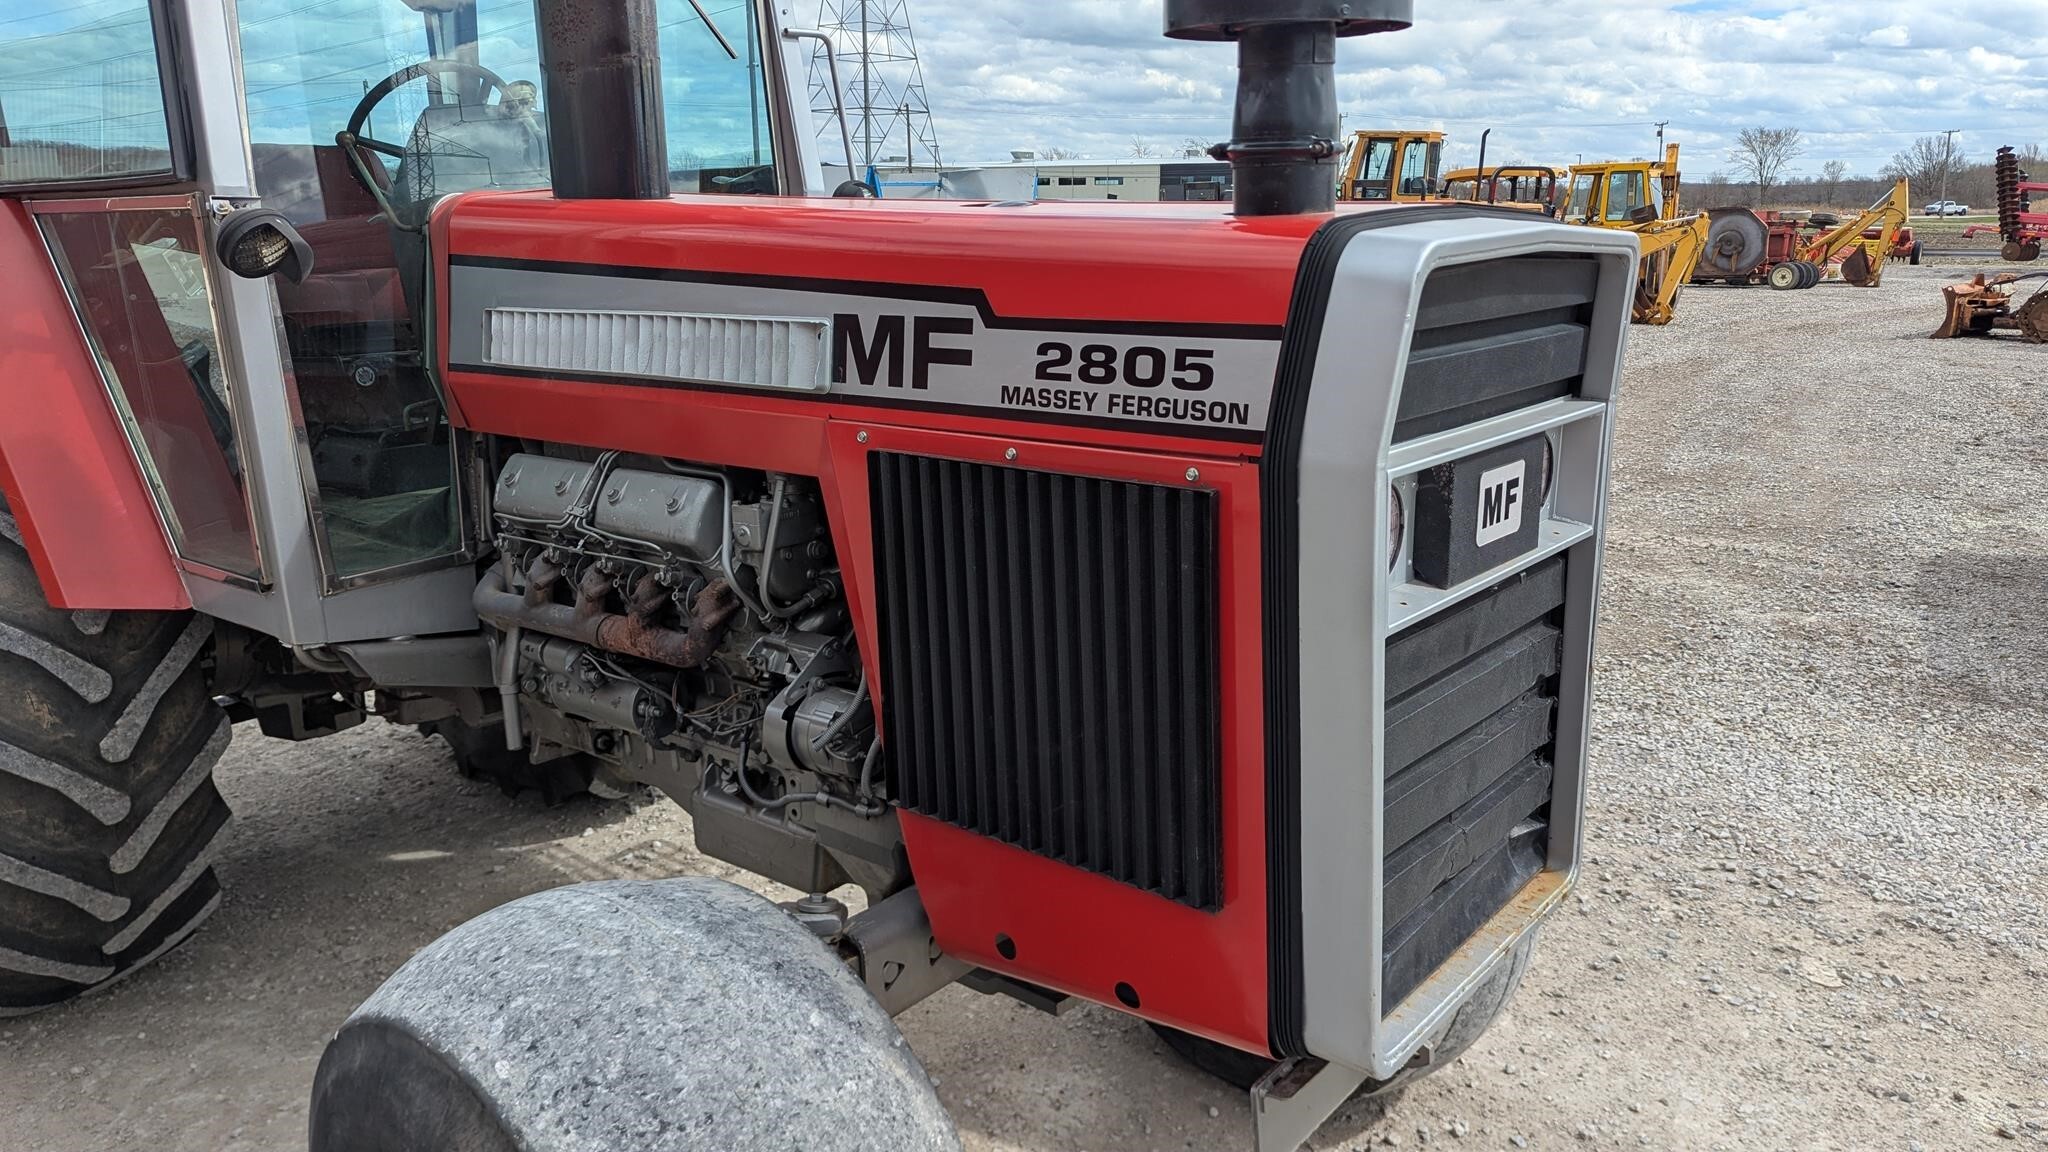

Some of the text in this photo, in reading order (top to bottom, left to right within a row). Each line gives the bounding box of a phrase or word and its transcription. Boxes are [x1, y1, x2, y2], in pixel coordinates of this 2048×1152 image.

[833, 313, 974, 390] MF
[1035, 341, 1215, 391] 2805
[1000, 385, 1250, 426] MASSEY FERGUSON
[1482, 477, 1520, 529] MF
